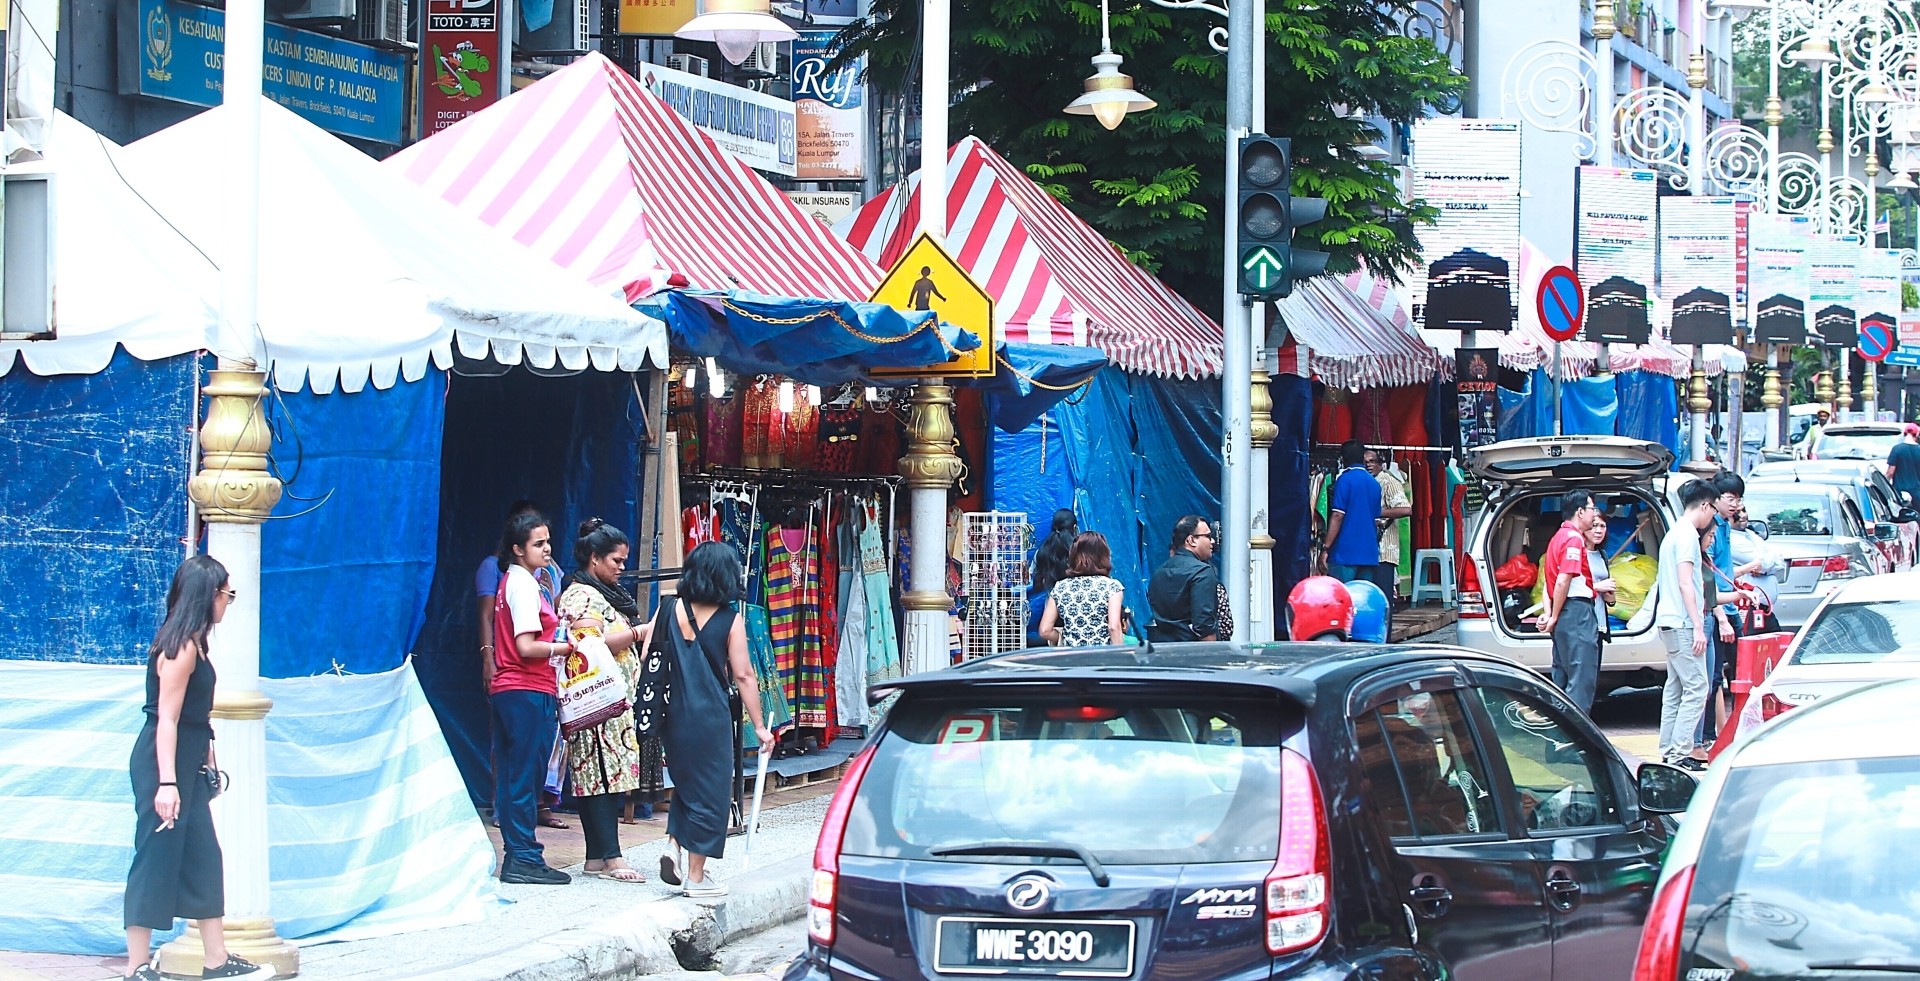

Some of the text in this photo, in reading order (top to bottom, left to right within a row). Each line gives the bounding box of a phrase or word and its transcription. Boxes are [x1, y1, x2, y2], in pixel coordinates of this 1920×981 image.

[433, 17, 463, 27] TOTO
[470, 17, 491, 28] 萬字
[179, 17, 399, 83] KESATUAN KASTAM SEMENANJUNG MALAYSIA
[286, 69, 311, 89] UNION
[314, 75, 325, 92] OF
[329, 79, 336, 95] P.
[339, 80, 377, 104] MALAYSIA
[794, 58, 856, 107] Raj
[437, 111, 460, 119] DIGIT
[798, 140, 829, 148] Brickfields
[812, 197, 850, 206] INSURANS
[939, 719, 985, 755] P
[977, 929, 1093, 961] WWE 3090
